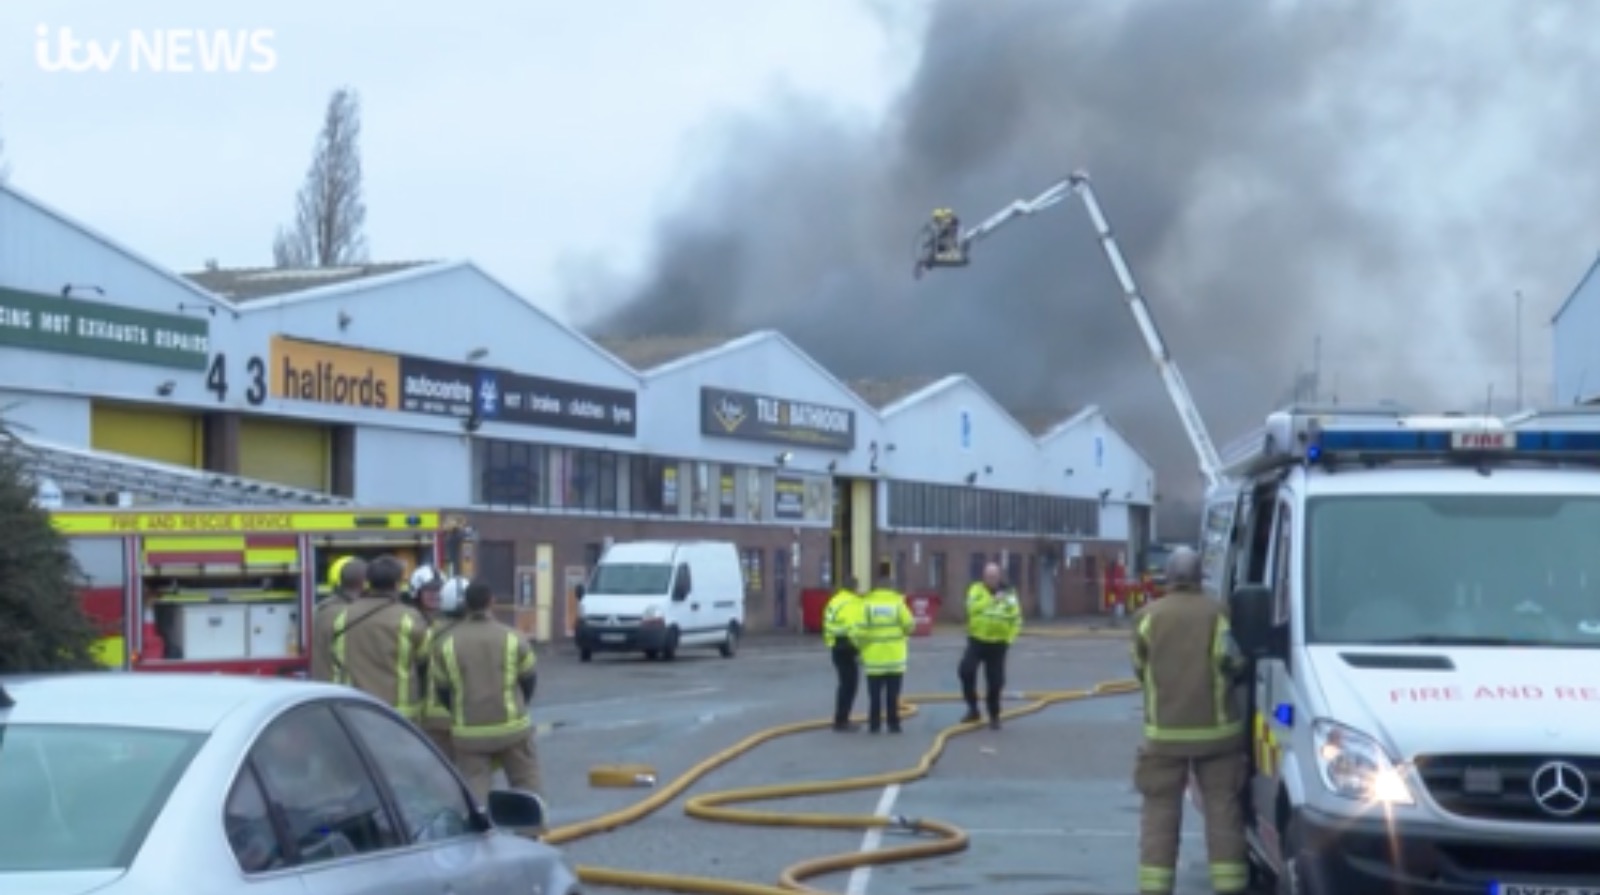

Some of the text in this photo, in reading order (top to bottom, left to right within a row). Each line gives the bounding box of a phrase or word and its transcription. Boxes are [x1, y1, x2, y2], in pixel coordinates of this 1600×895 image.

[207, 353, 228, 402] 4
[246, 356, 267, 405] 3
[283, 355, 388, 408] halfords
[405, 374, 472, 402] autocentre
[756, 397, 779, 425] TILE
[1462, 432, 1504, 449] FIRE
[869, 440, 878, 474] 2
[111, 513, 295, 530] FIRE AND RESCUE SERVICE
[1389, 685, 1461, 703] FIRE
[1474, 684, 1543, 700] AND
